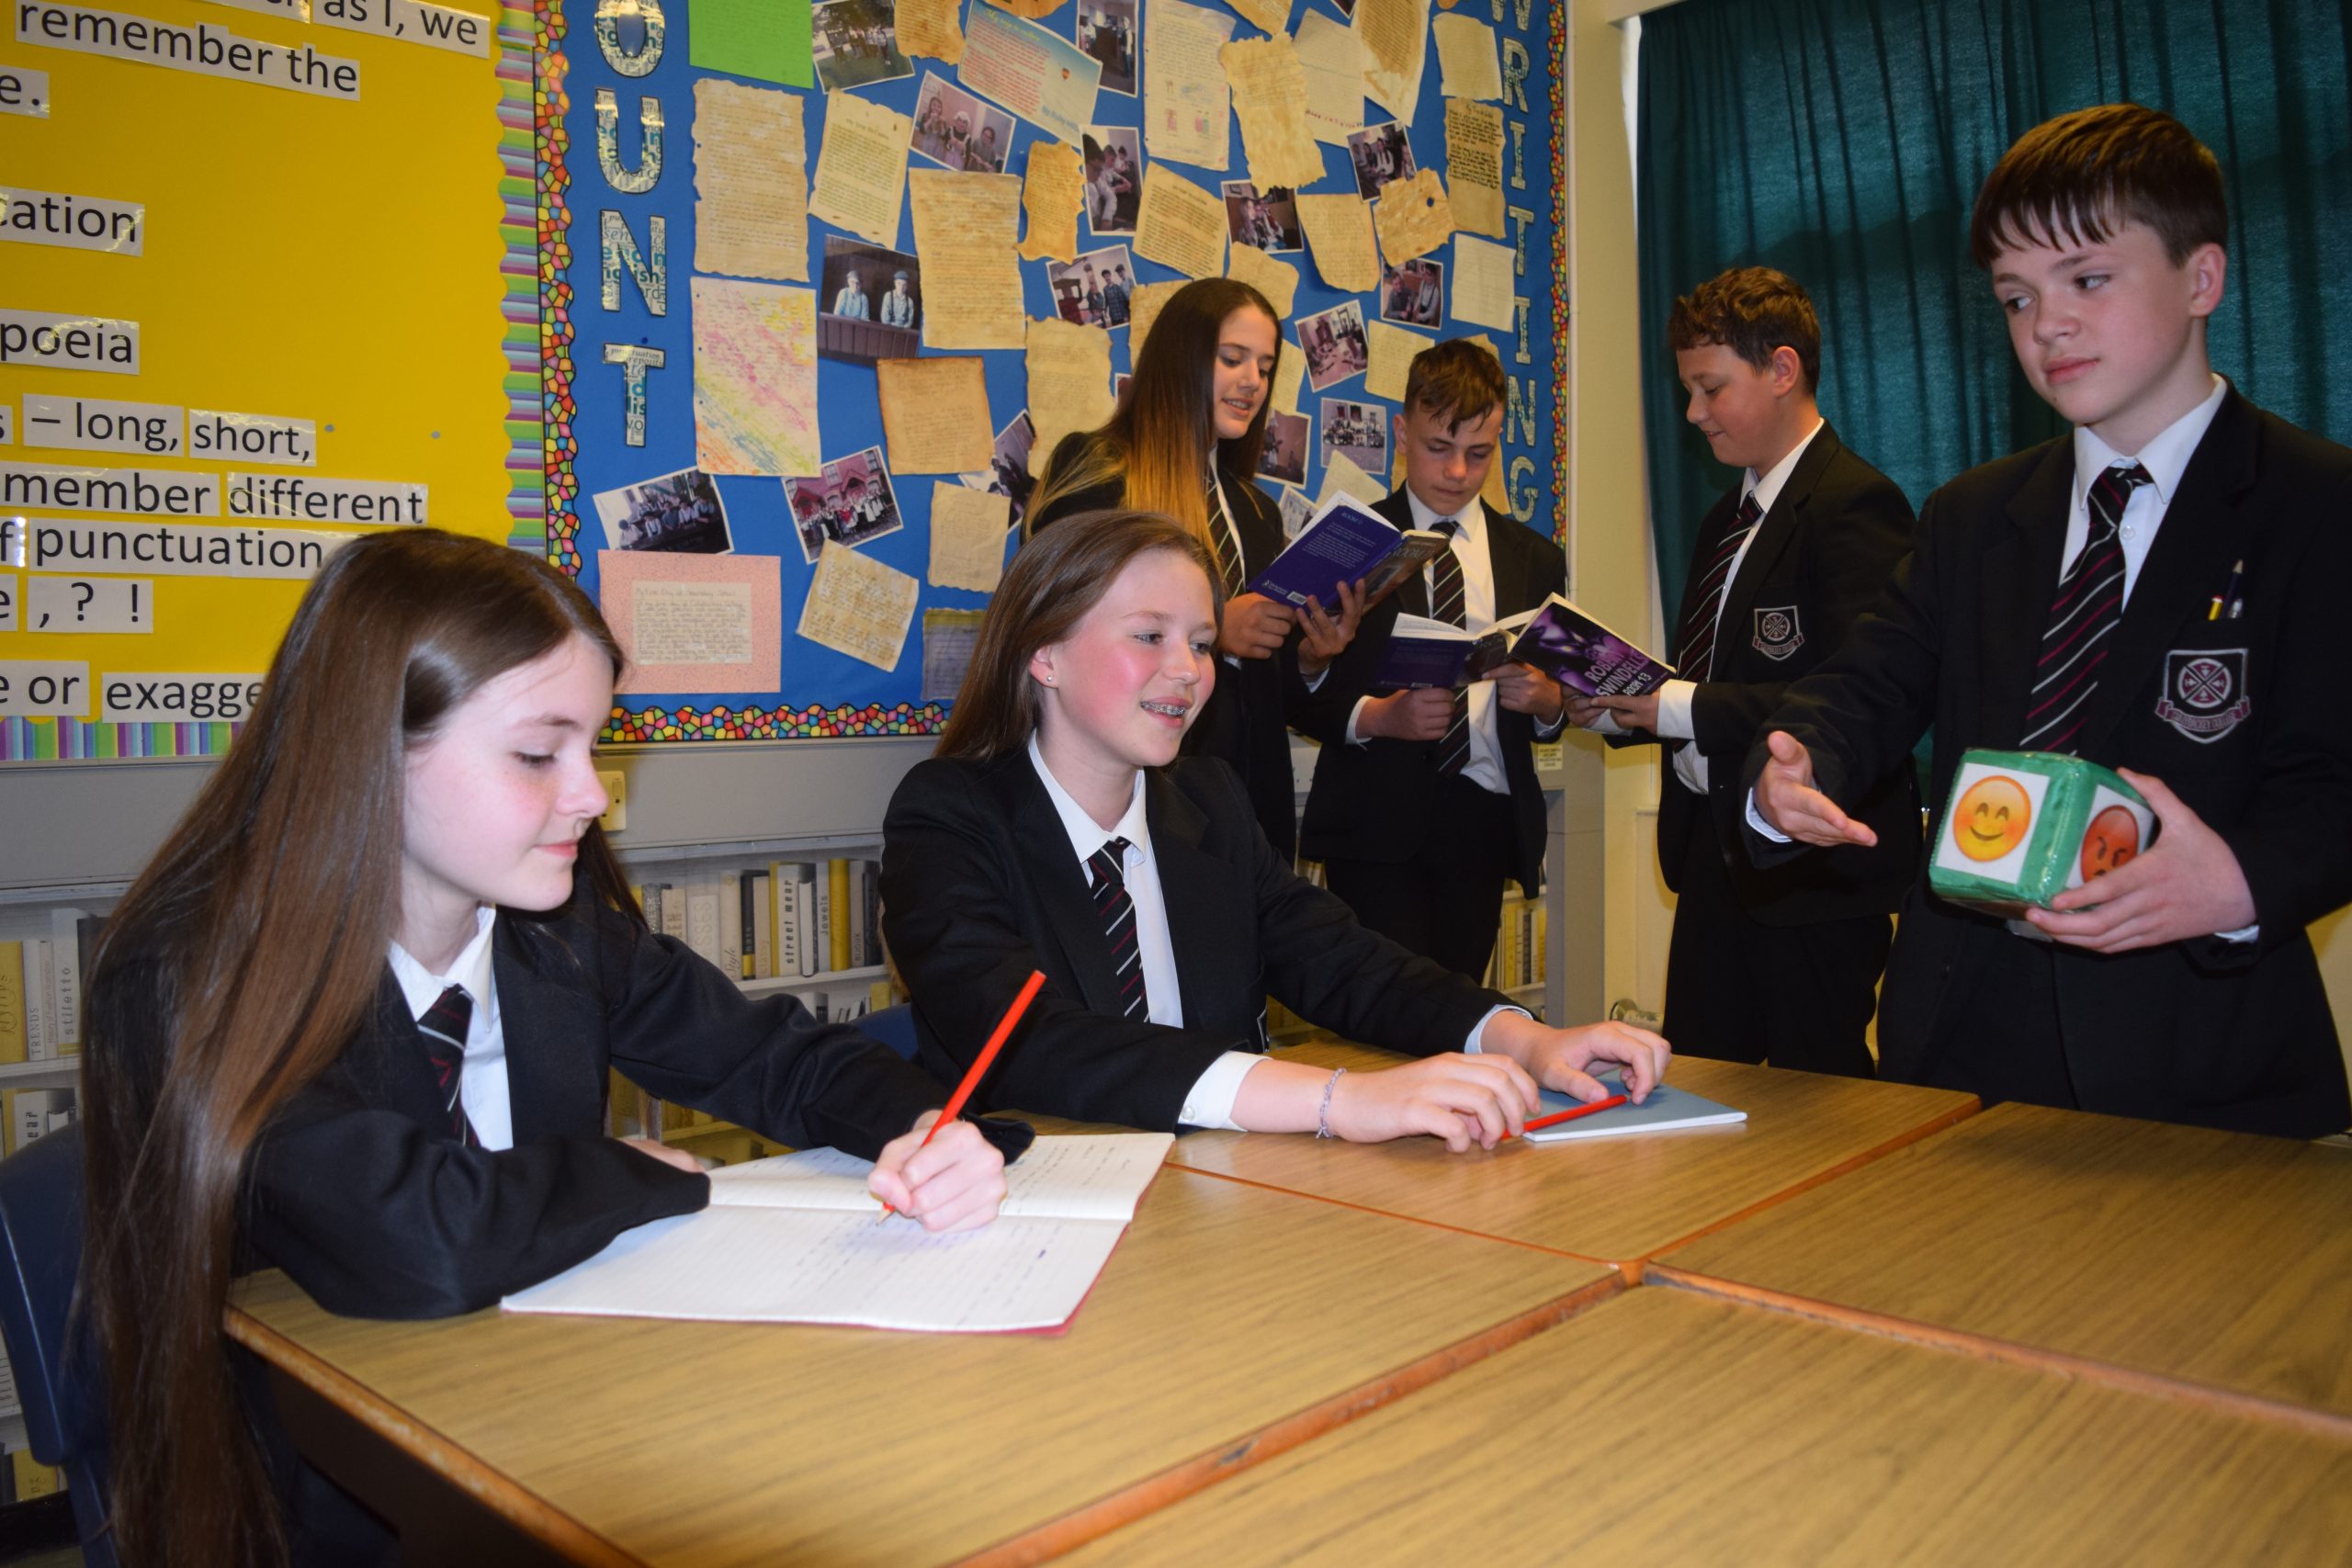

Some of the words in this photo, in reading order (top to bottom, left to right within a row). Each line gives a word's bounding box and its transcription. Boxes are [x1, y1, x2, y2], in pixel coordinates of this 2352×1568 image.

[323, 0, 368, 22] as
[420, 9, 477, 45] we
[20, 4, 273, 74] remember
[286, 48, 356, 92] the
[0, 323, 131, 364] poeia
[76, 401, 178, 452] long,
[194, 417, 310, 461] short,
[5, 472, 210, 513] member
[230, 477, 423, 525] different
[37, 527, 322, 570] punctuation
[28, 676, 80, 705] or
[784, 919, 795, 964] street
[61, 967, 74, 1035] stiletto
[29, 1007, 41, 1056] TRENDS
